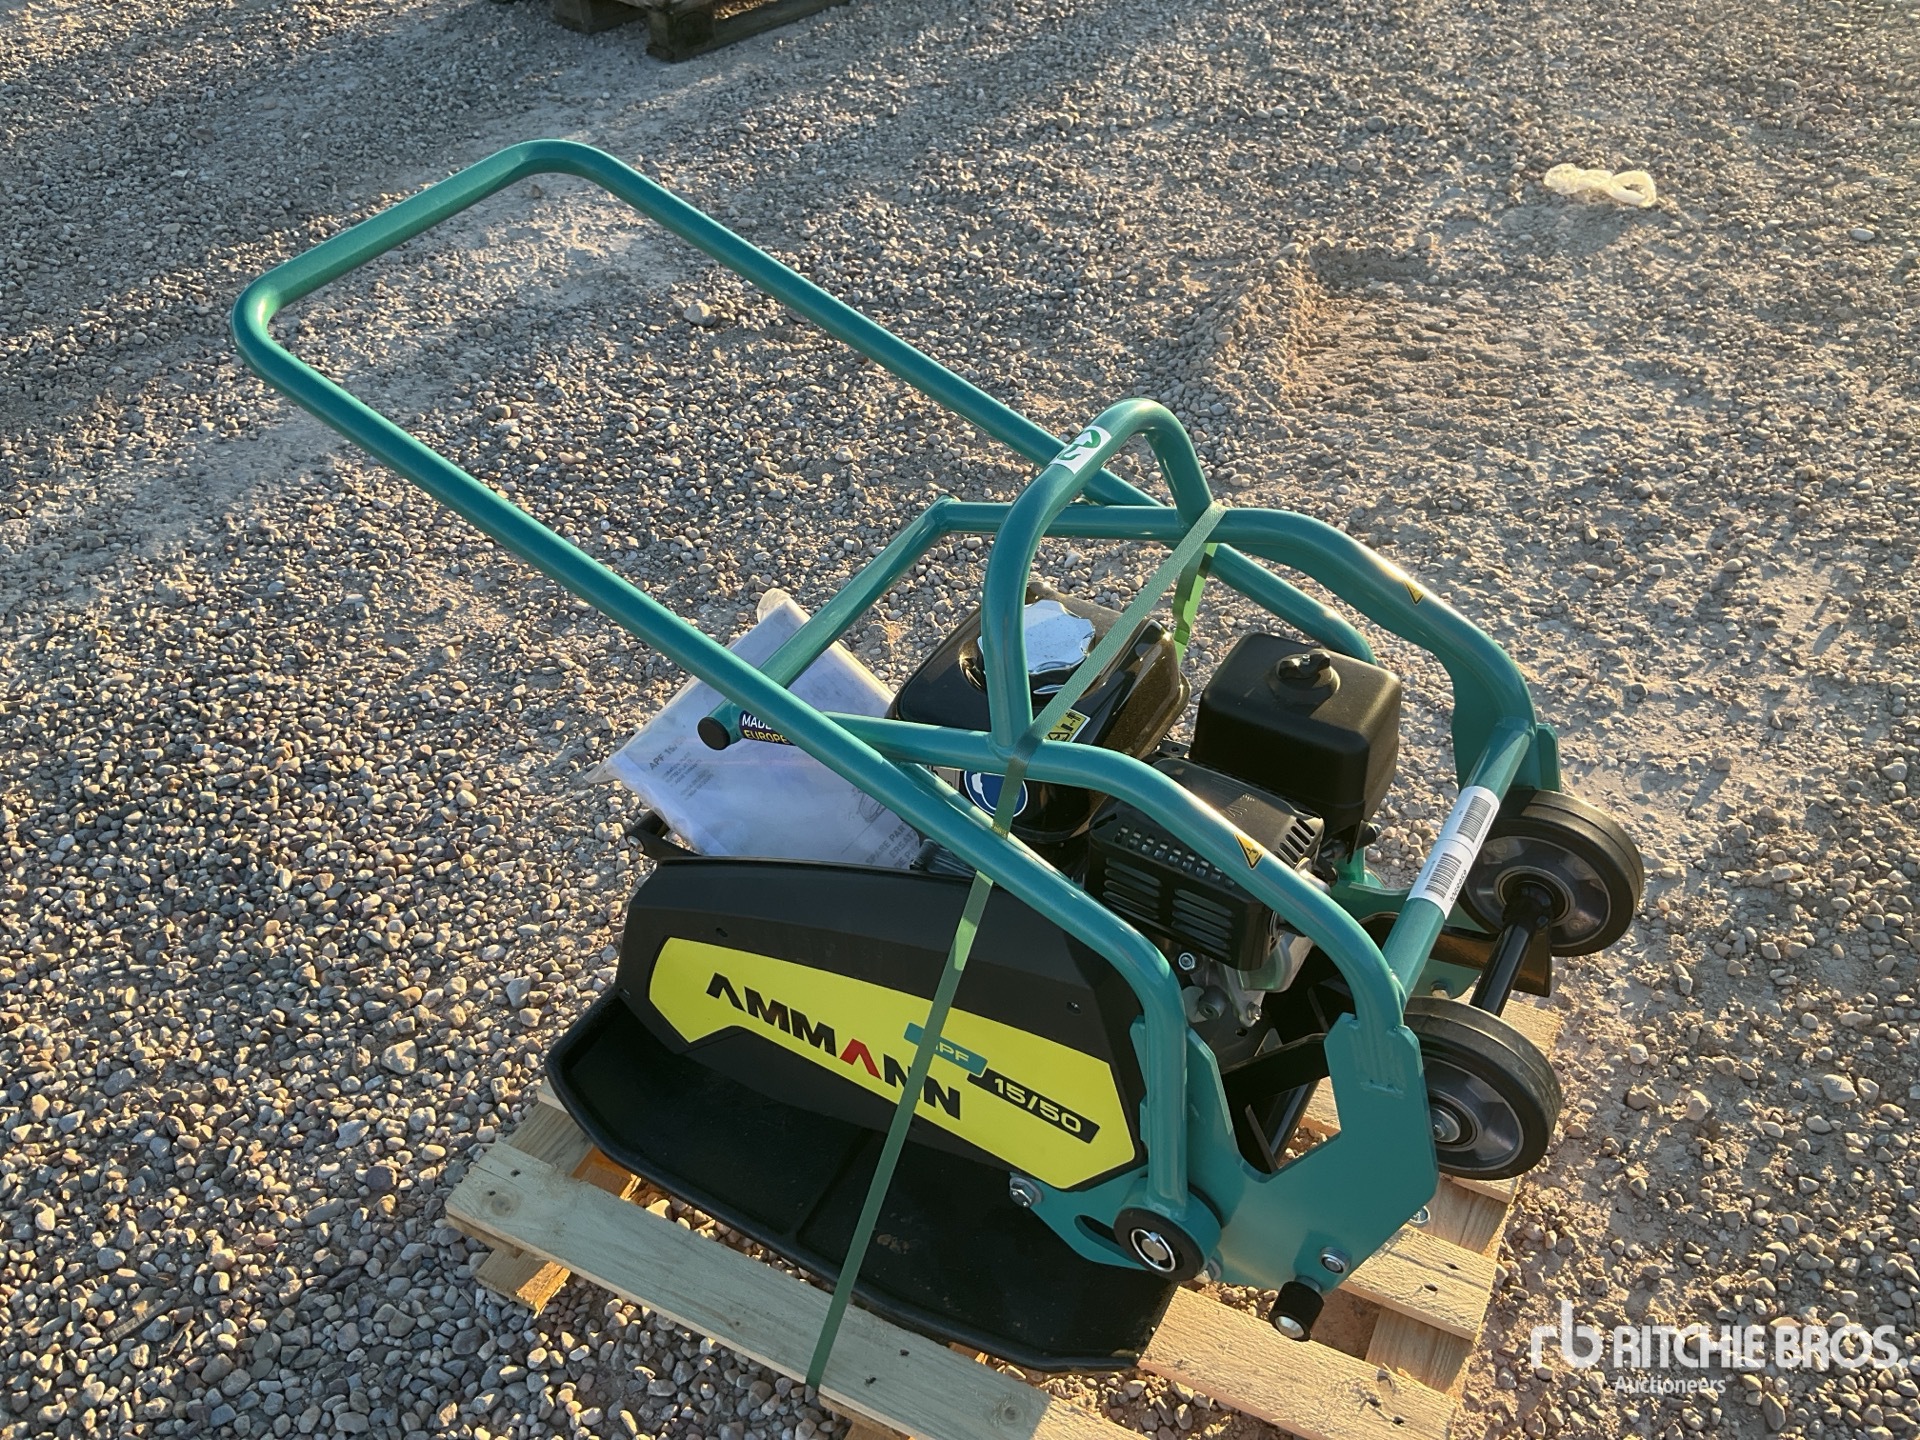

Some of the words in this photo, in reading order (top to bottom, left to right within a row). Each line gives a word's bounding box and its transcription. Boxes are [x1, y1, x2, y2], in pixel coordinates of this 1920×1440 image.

[741, 713, 772, 730] MAD
[743, 729, 790, 745] EUROPE
[649, 753, 664, 770] APF
[865, 840, 891, 865] SPARE
[706, 972, 960, 1120] AMMANN
[935, 1041, 969, 1062] PF
[995, 1078, 1081, 1133] 15/50
